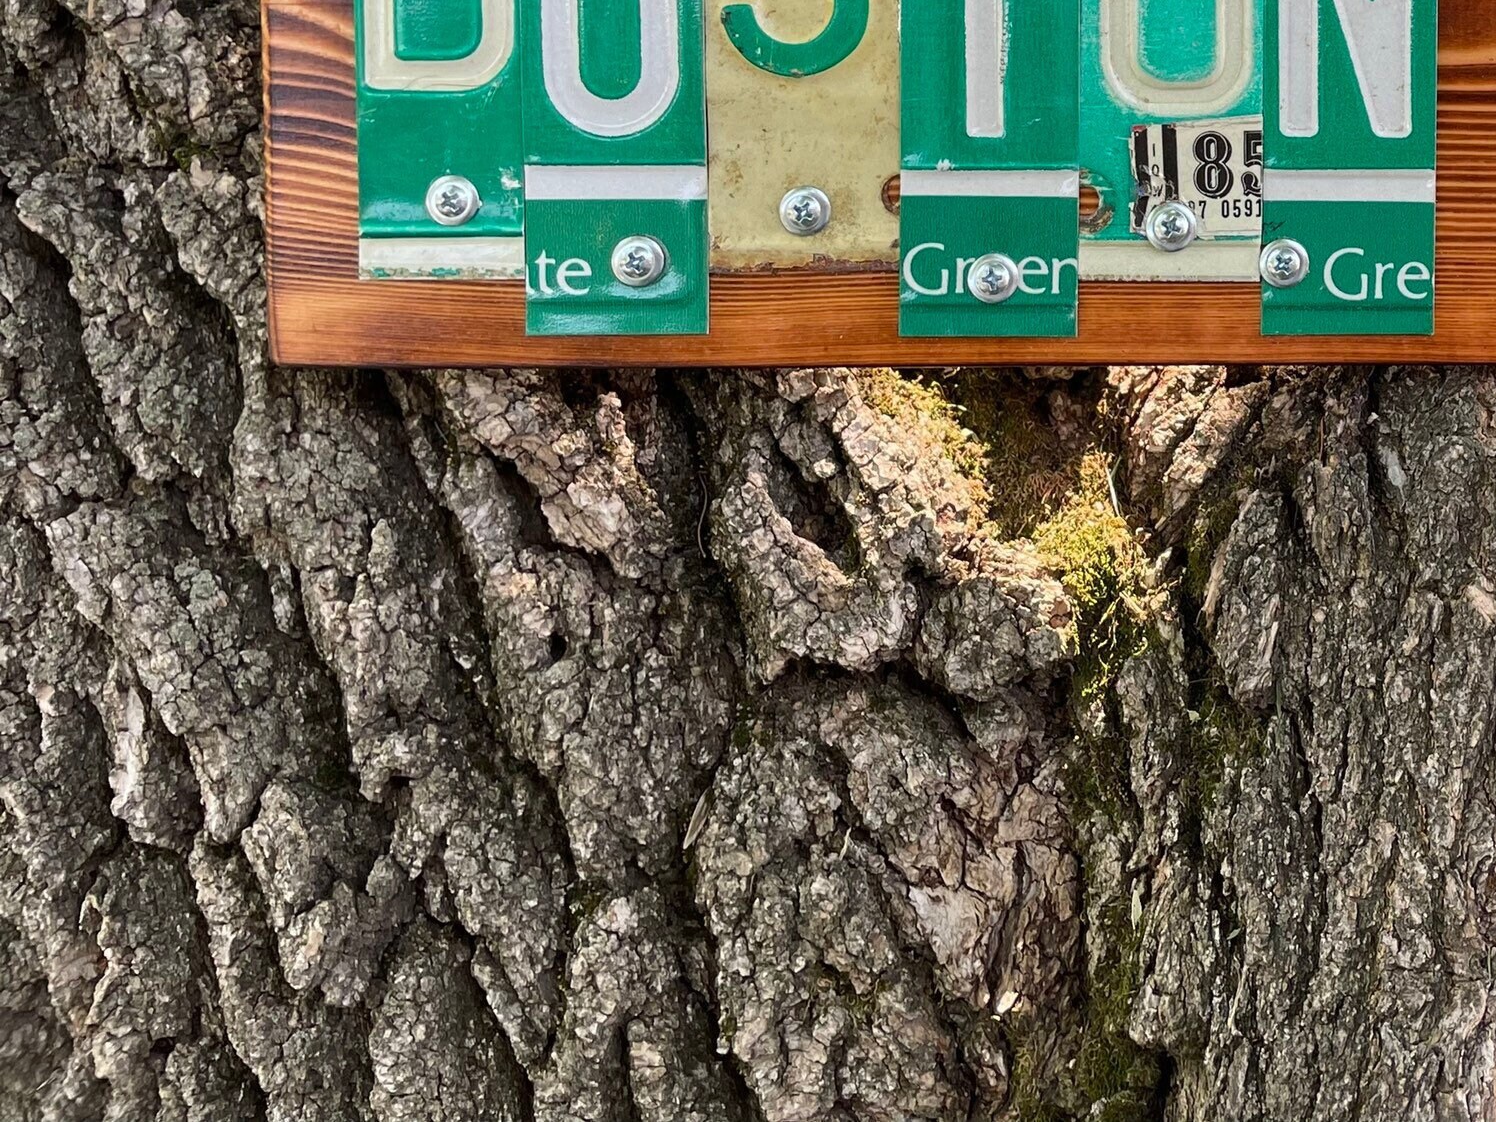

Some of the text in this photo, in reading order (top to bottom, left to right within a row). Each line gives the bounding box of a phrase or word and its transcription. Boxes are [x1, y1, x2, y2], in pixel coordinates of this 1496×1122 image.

[1192, 130, 1262, 200] 85
[525, 249, 593, 296] te
[902, 242, 1079, 296] Gren
